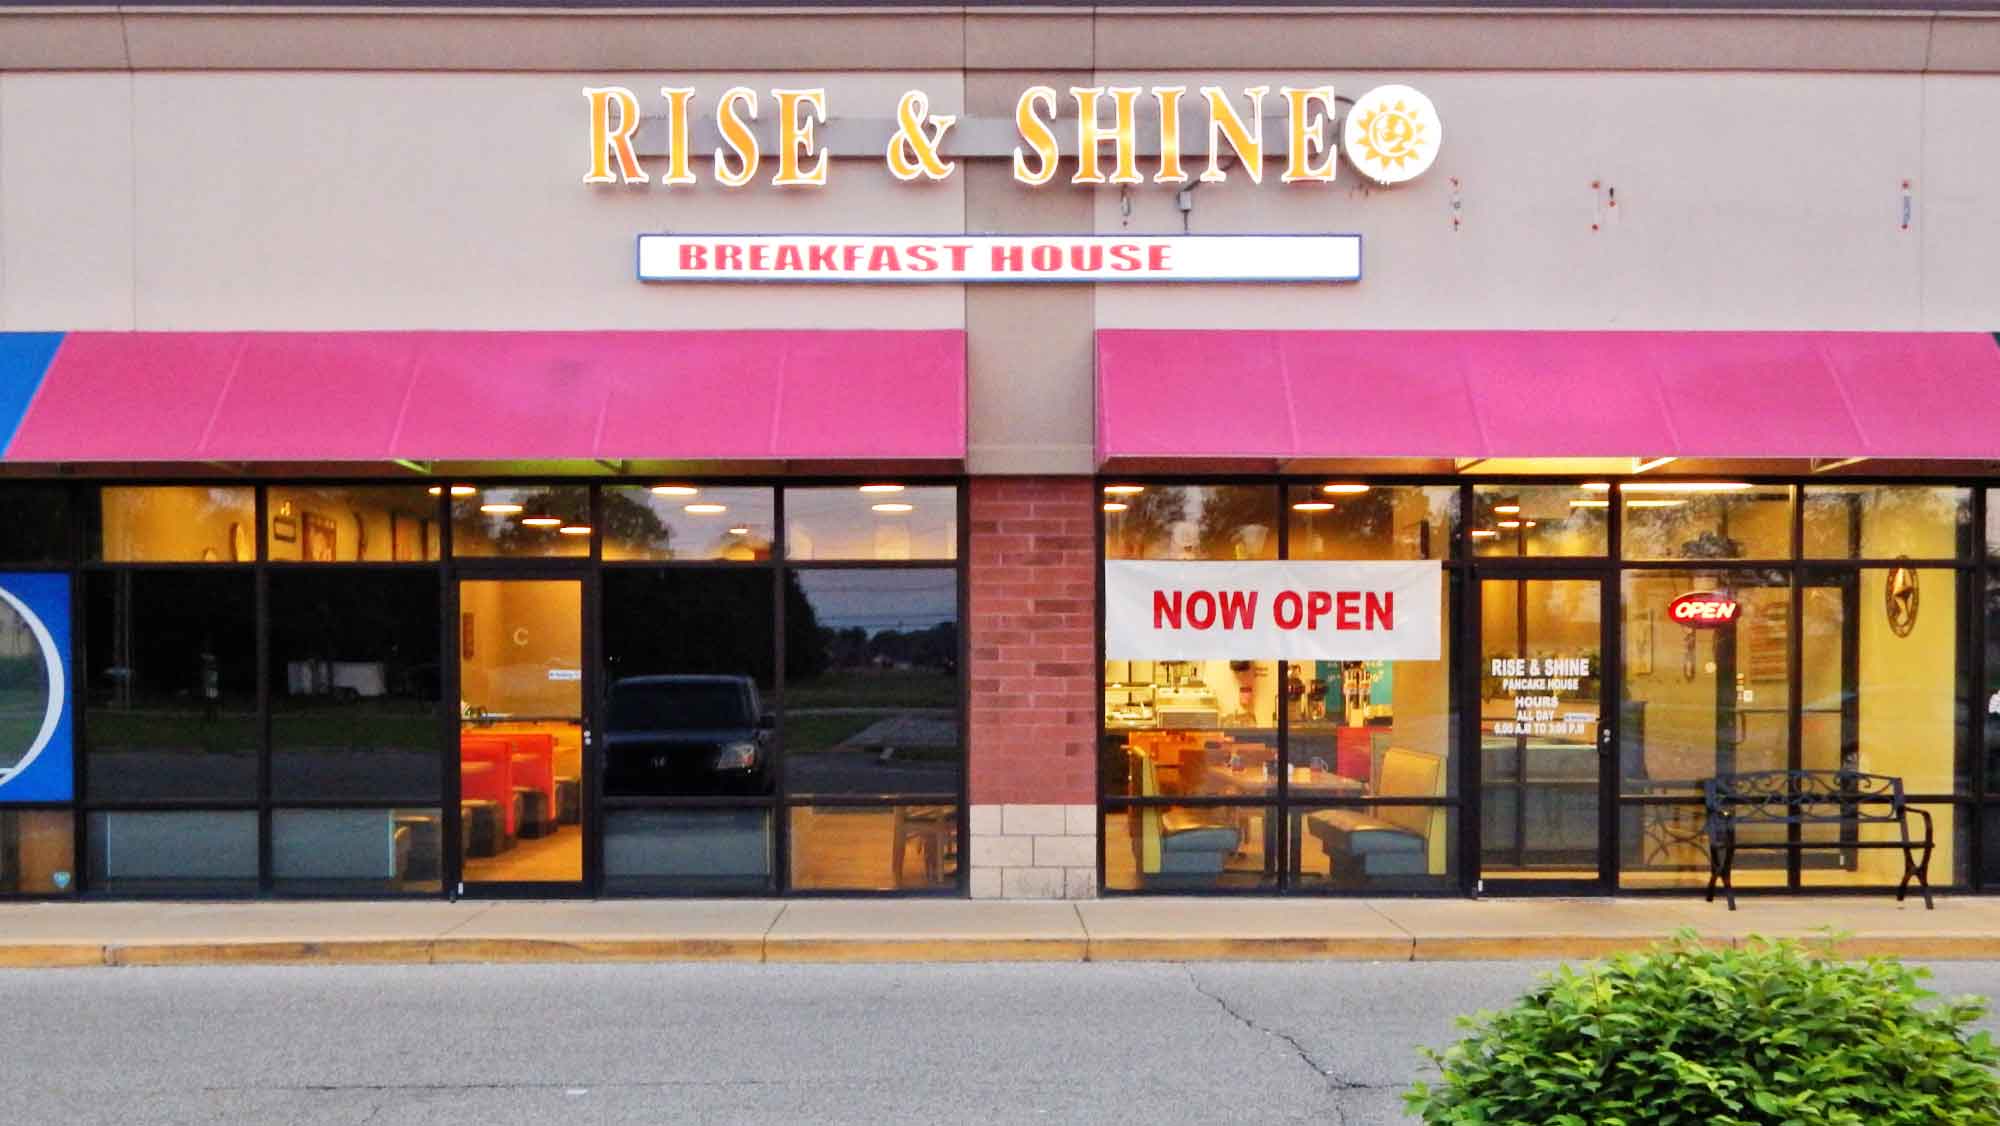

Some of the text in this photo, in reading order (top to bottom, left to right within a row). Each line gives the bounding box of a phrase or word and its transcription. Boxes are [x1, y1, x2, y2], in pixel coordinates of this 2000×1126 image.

[583, 86, 1338, 186] RISE & SHINE
[678, 244, 1173, 271] BREAKFAST HOUSE
[1153, 590, 1394, 630] NOW OPEN
[1674, 602, 1736, 618] OPEN
[1492, 659, 1589, 676] RISE & SHINE
[1503, 679, 1578, 690] PANCAKE HOUSE
[1515, 696, 1558, 709] HOURS
[1517, 710, 1534, 721] ALL
[1536, 710, 1554, 721] DAY
